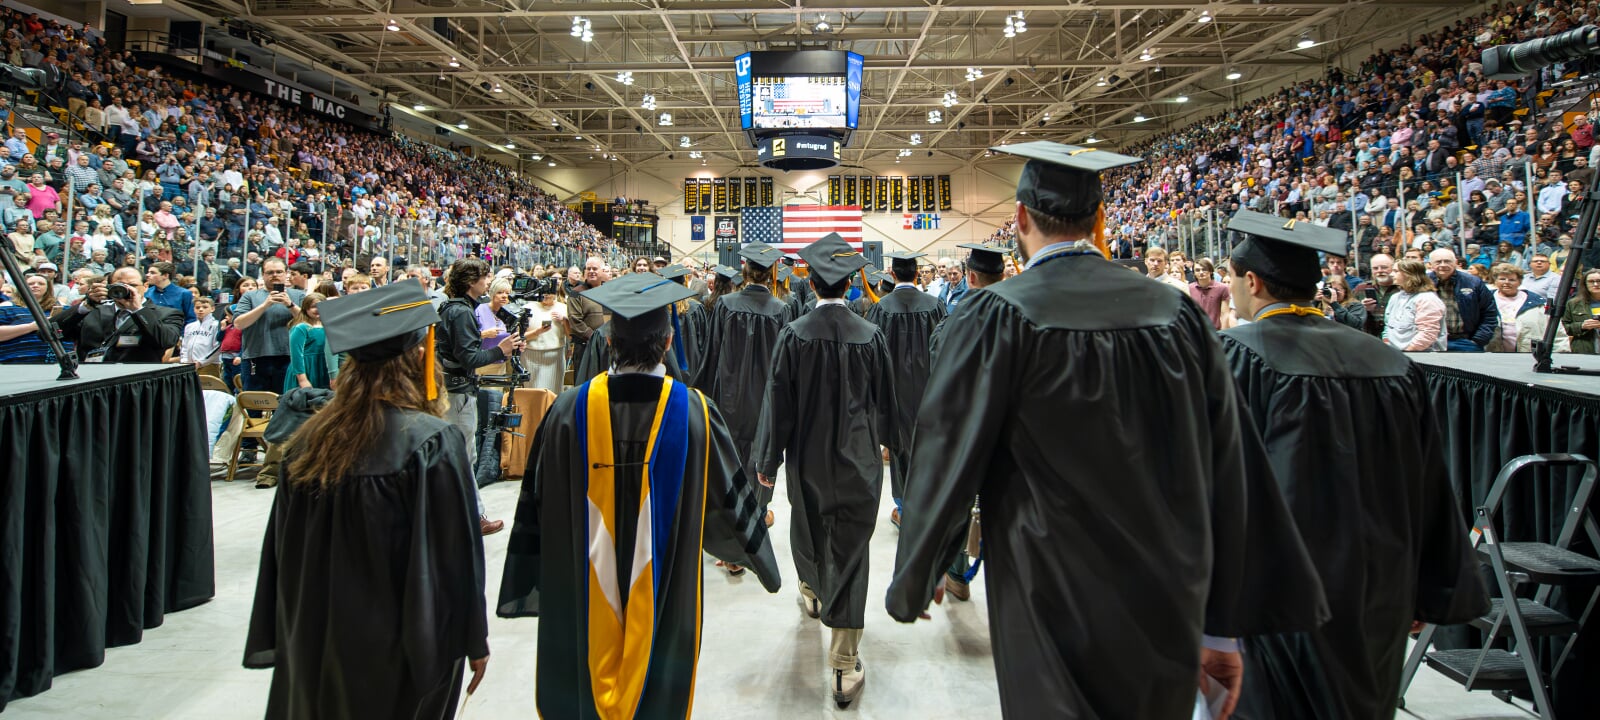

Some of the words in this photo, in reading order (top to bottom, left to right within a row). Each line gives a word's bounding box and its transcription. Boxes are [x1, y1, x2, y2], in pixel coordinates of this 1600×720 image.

[735, 56, 751, 77] UP
[264, 79, 302, 105] THE
[312, 96, 346, 119] MAC
[796, 142, 827, 151] #mtugrad
